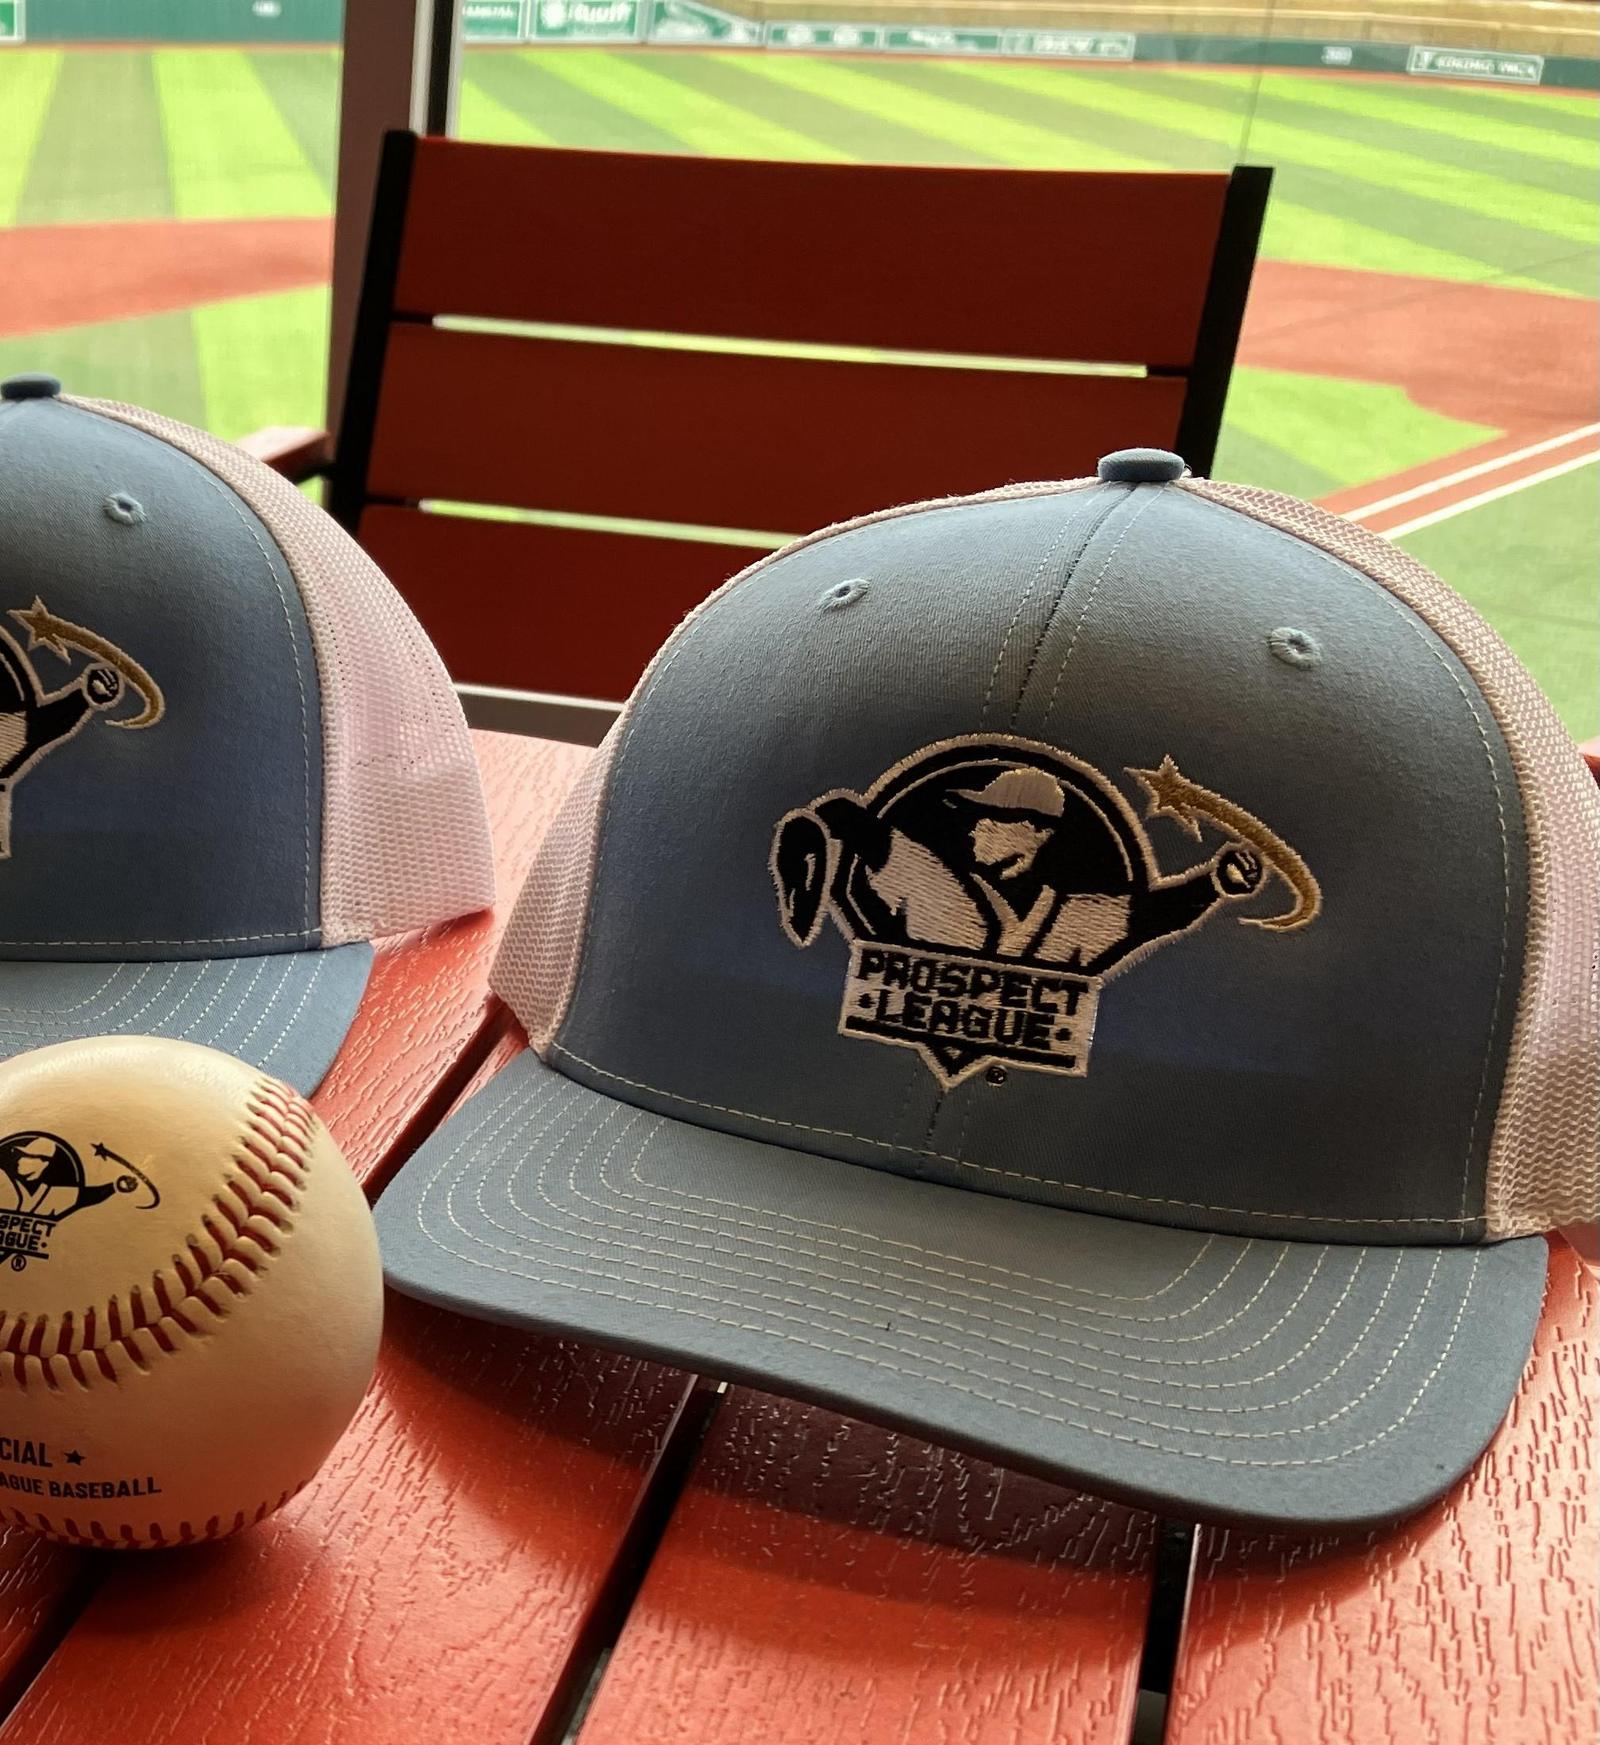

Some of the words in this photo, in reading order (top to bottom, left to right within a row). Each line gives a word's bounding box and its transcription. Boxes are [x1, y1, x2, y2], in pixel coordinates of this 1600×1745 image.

[856, 948, 1090, 1016] PROSPECT
[875, 988, 1057, 1051] LEAGUE
[48, 1475, 163, 1500] BASEBALL
